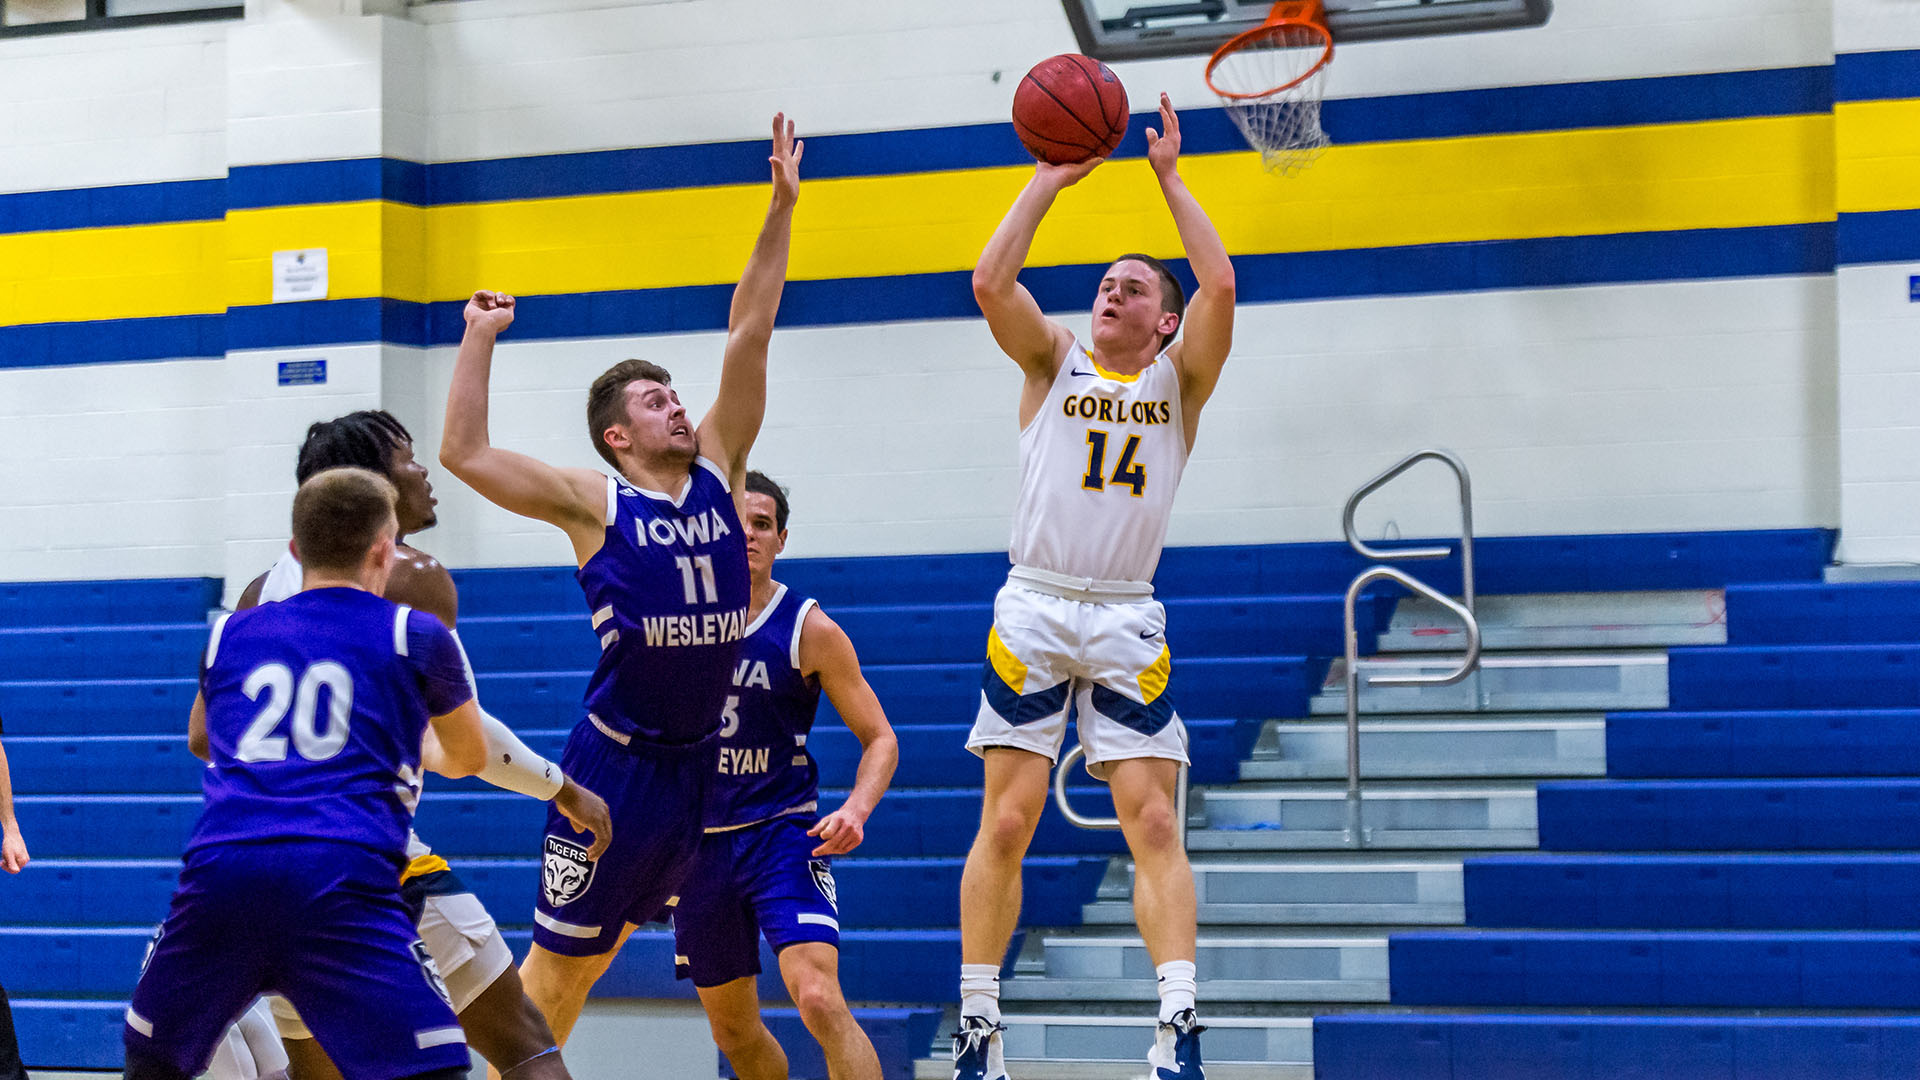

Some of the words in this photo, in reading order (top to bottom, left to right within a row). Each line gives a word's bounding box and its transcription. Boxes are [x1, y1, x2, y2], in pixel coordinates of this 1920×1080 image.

[1063, 395, 1170, 425] GORLOKS
[1081, 429, 1147, 498] 14
[635, 508, 730, 546] IOWA
[675, 554, 719, 604] 11
[642, 607, 747, 647] WESLEYAN
[233, 661, 354, 763] 20
[549, 839, 587, 862] TIGERS
